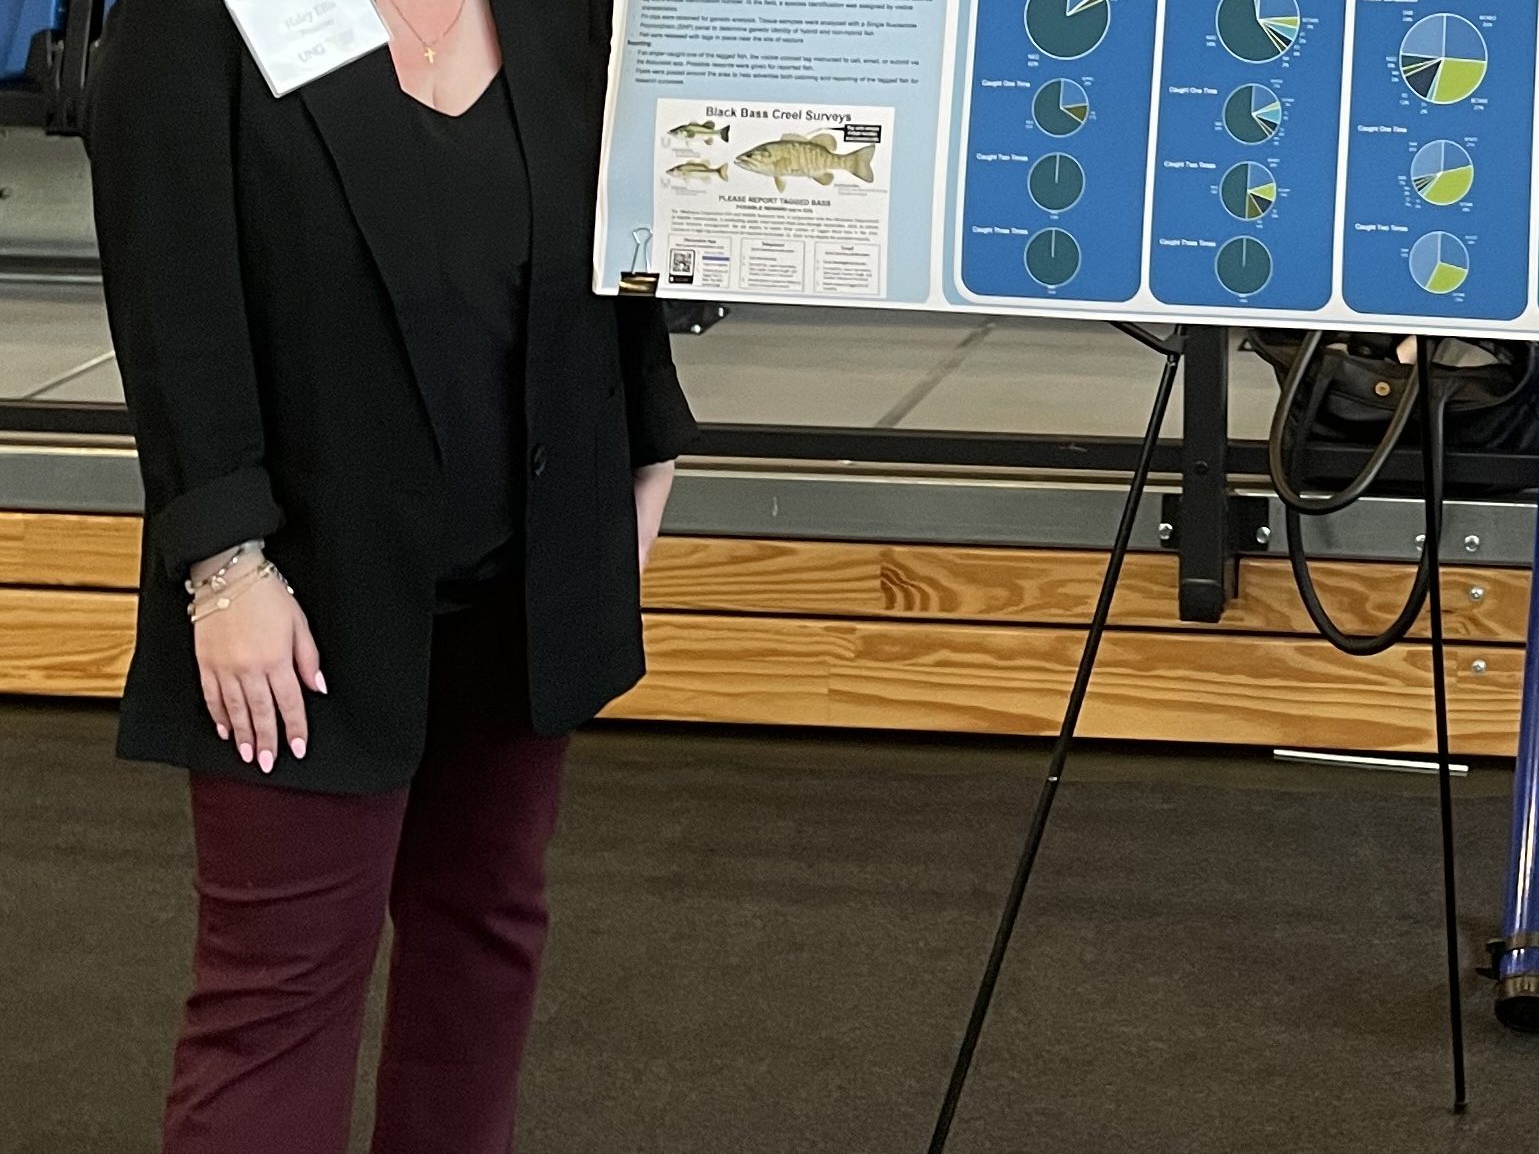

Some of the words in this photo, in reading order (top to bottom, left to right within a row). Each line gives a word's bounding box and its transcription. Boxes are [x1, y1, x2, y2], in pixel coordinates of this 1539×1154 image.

[706, 106, 737, 118] Black
[741, 107, 768, 118] Bass
[772, 109, 801, 120] Creel
[805, 110, 852, 123] Surveys
